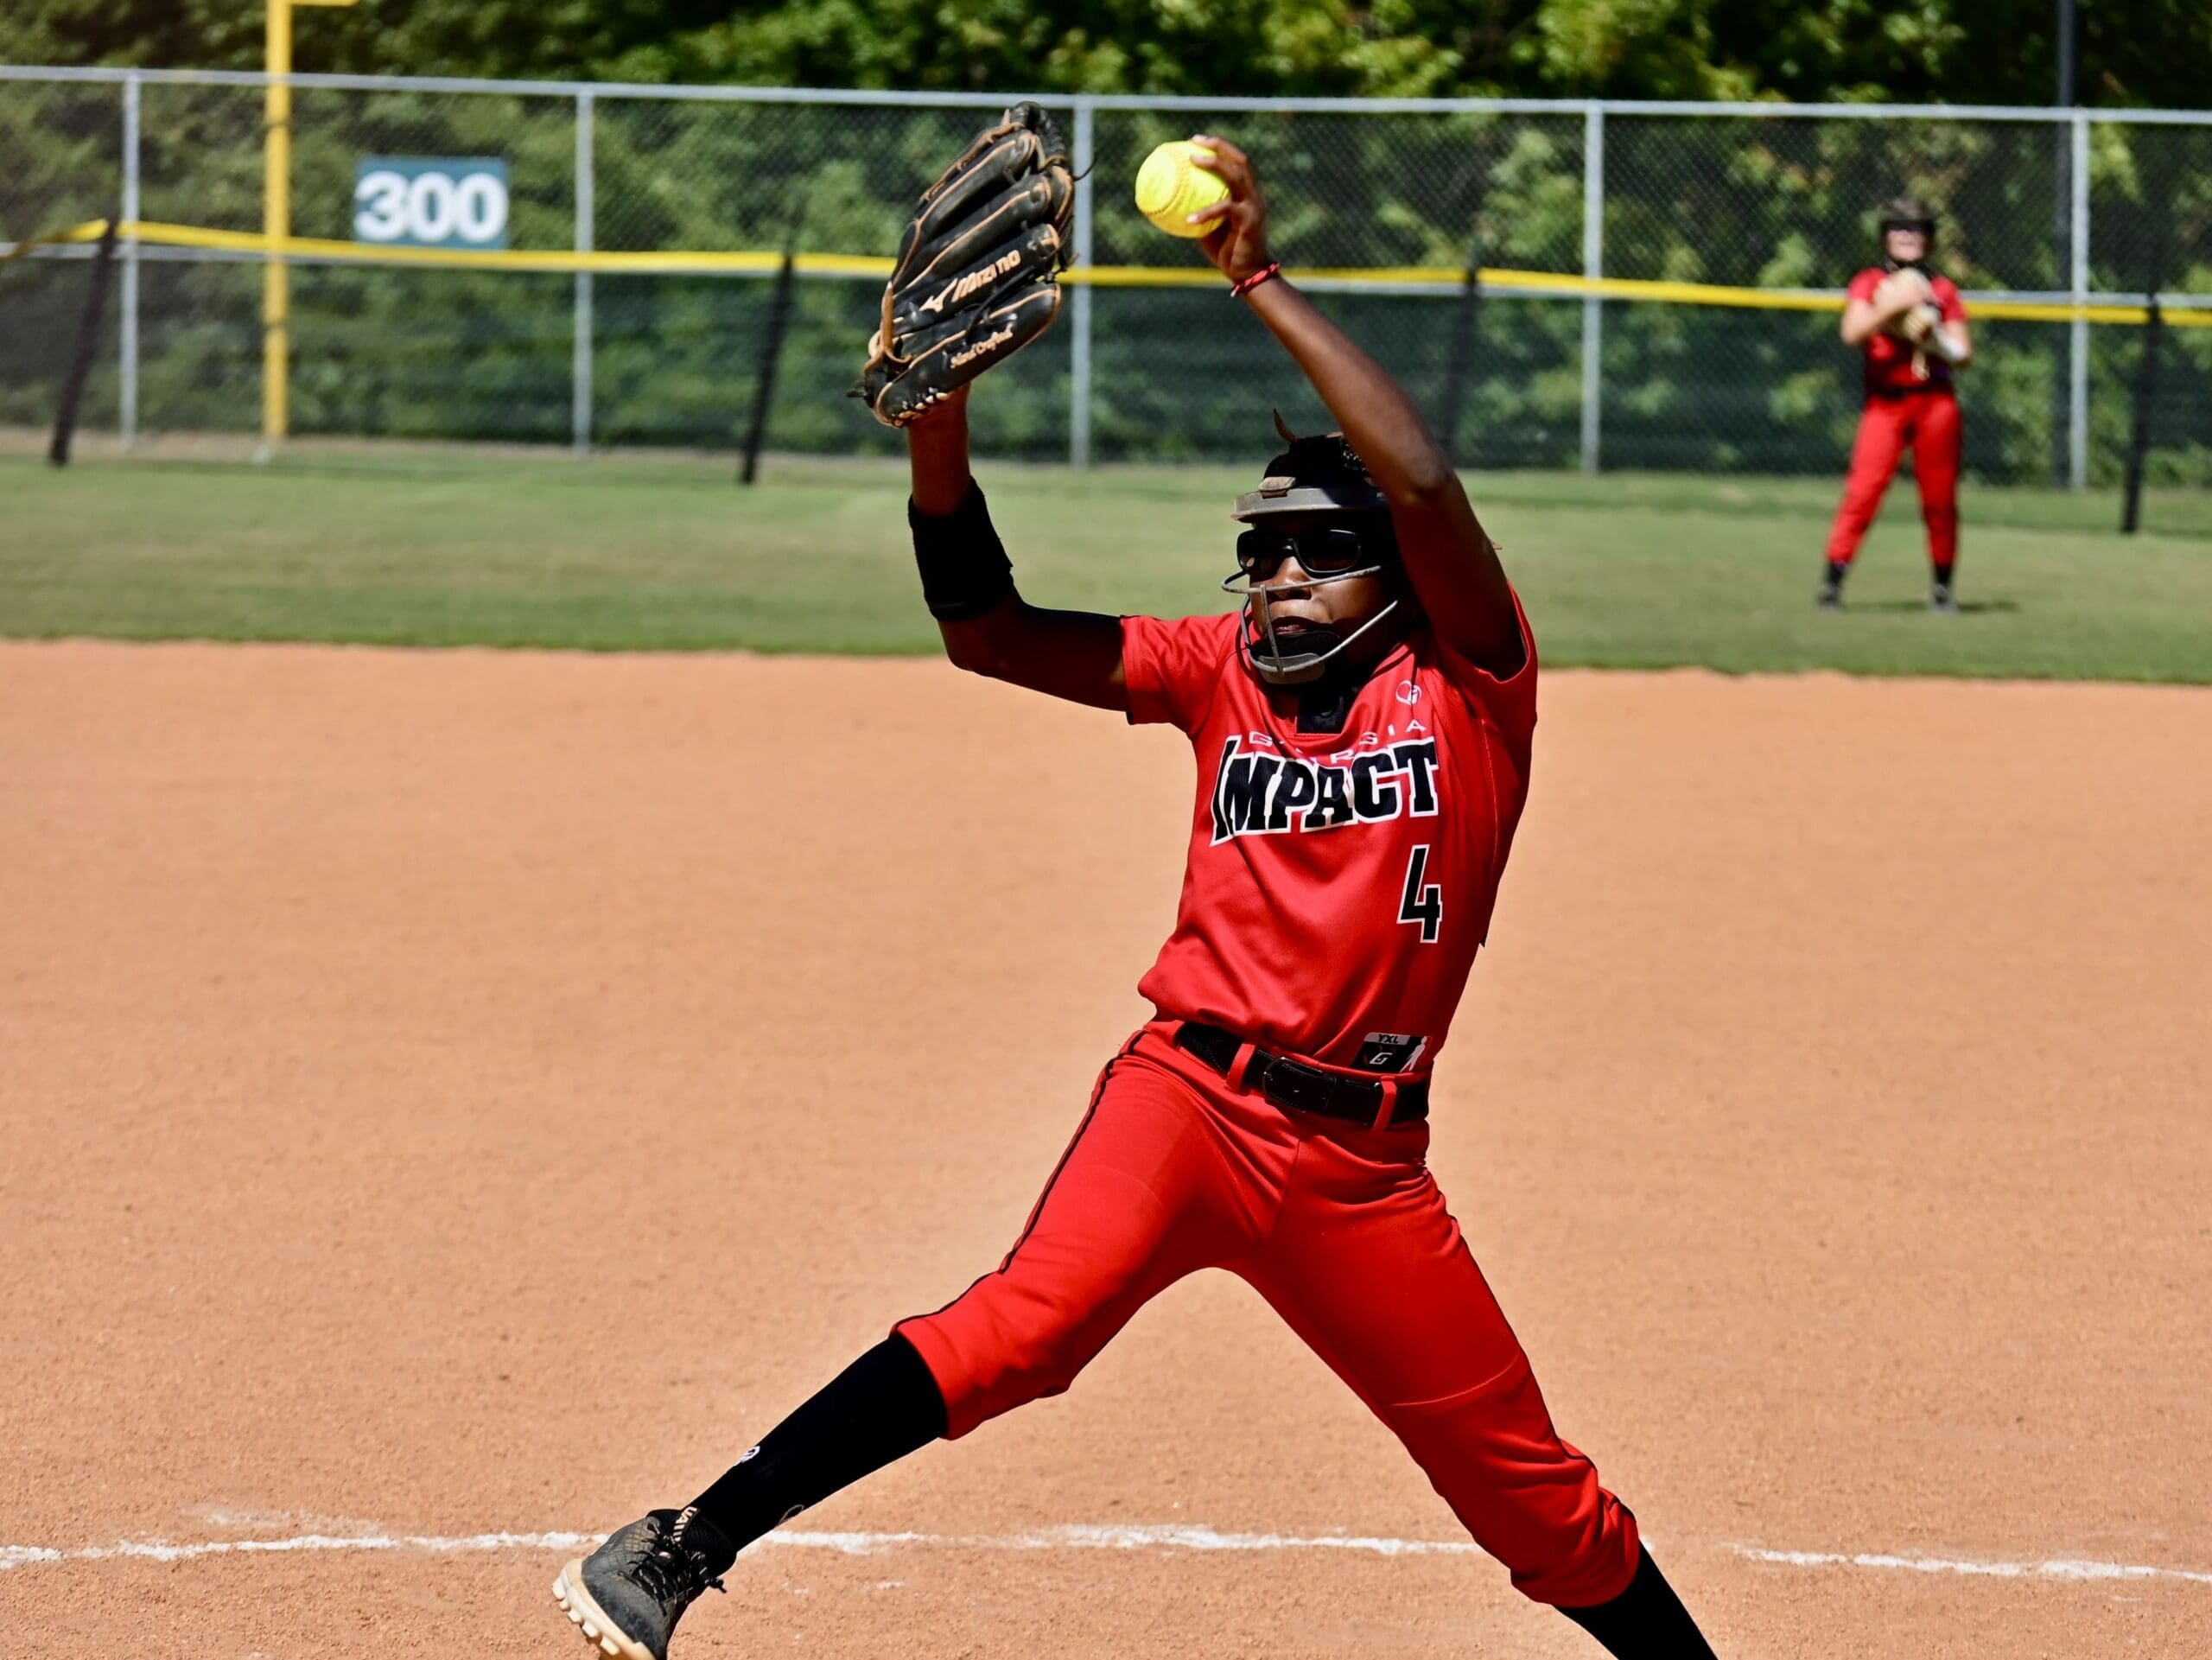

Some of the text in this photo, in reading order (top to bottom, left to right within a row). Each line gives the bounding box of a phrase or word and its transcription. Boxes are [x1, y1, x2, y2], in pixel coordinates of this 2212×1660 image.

[354, 170, 509, 243] 300
[1210, 735, 1440, 846] IMPACT
[1396, 843, 1443, 944] 4
[1377, 1034, 1399, 1044] YXL
